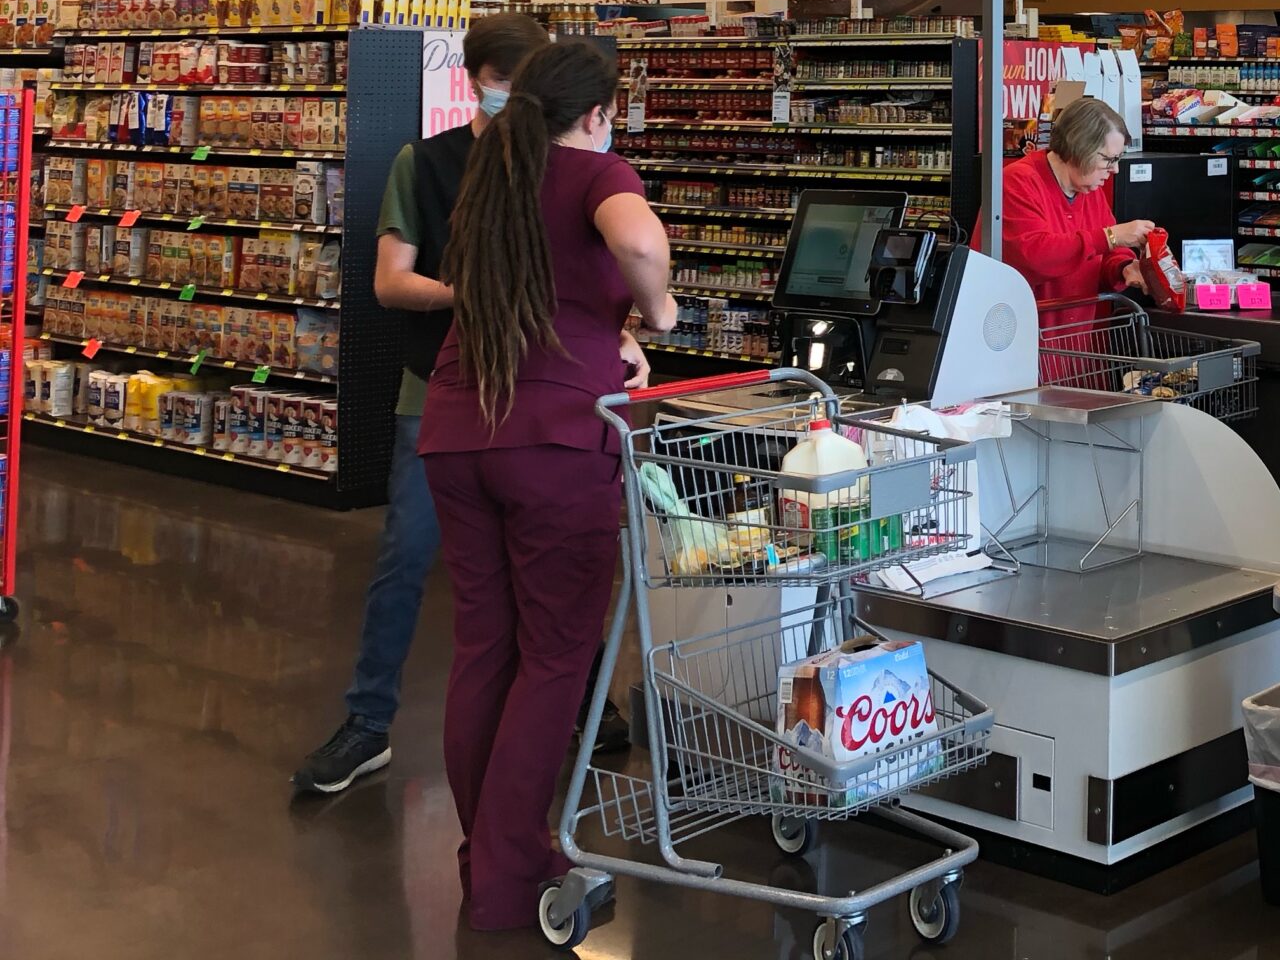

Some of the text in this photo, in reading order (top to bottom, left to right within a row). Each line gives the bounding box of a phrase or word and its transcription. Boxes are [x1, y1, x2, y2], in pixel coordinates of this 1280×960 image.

[1025, 47, 1067, 81] HOM
[1002, 85, 1041, 119] OWN
[826, 671, 835, 680] 12
[836, 688, 936, 751] Coors
